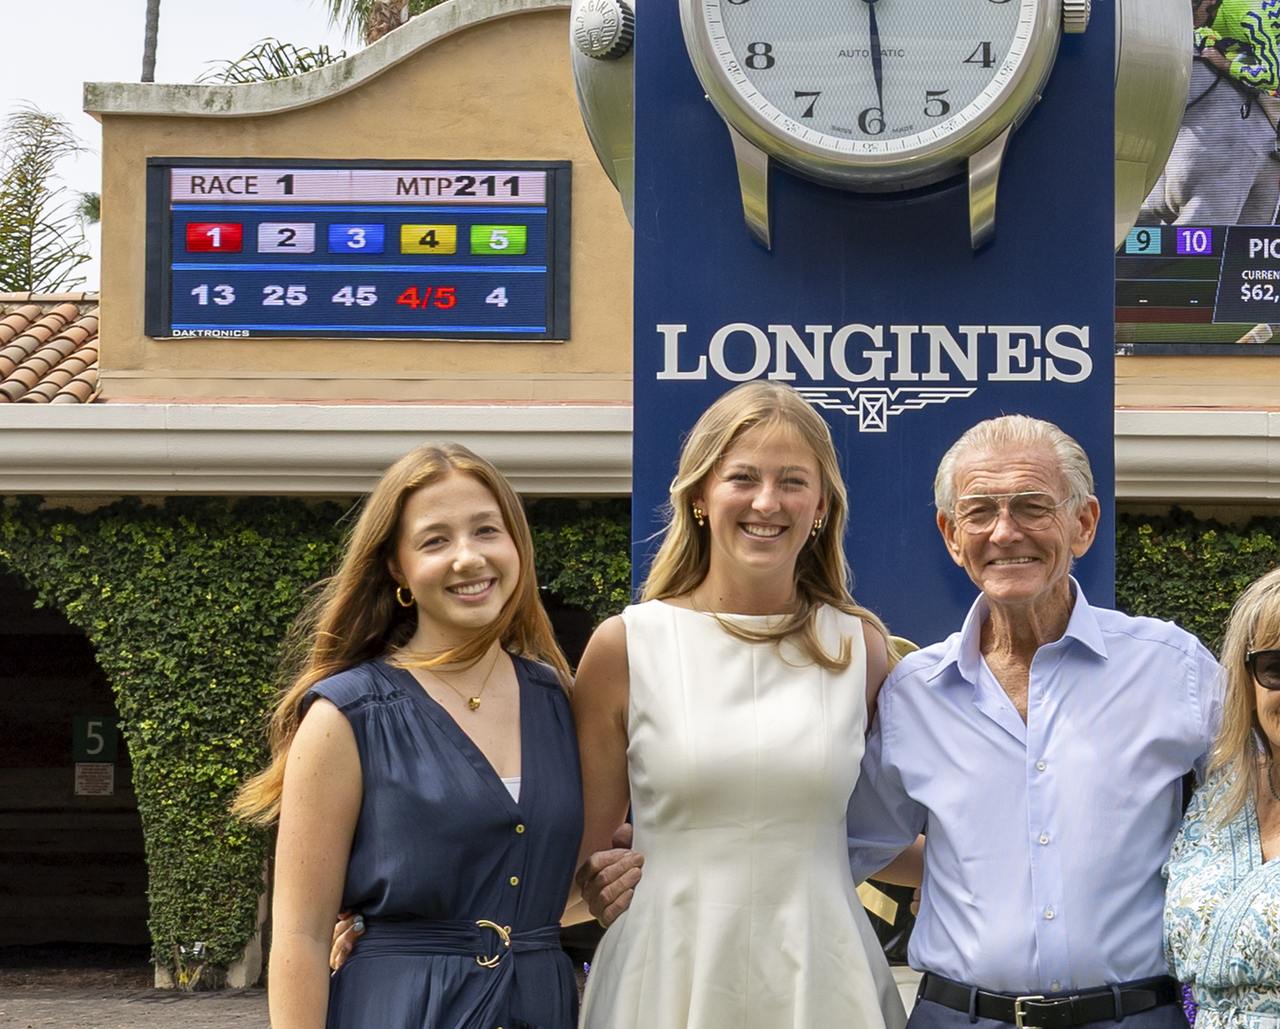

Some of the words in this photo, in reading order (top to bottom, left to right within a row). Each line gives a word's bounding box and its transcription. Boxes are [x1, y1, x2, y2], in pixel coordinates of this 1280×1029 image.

[745, 42, 775, 69] 8
[838, 49, 905, 58] AUTOATIC
[963, 42, 995, 68] 4
[795, 91, 821, 118] 7
[924, 89, 950, 117] 5
[858, 107, 886, 135] 6
[190, 175, 258, 195] RACE
[277, 174, 294, 195] 1
[207, 228, 221, 247] 1
[277, 228, 296, 247] 2
[347, 229, 366, 248] 3
[419, 230, 439, 248] 4
[490, 230, 509, 249] 5
[1137, 230, 1151, 251] 9
[1182, 231, 1207, 252] 10
[191, 285, 235, 305] 13
[263, 286, 307, 305] 25
[332, 286, 377, 306] 45
[397, 287, 457, 309] 4/5
[486, 287, 508, 308] 4
[172, 329, 250, 337] DAKTRONICS
[656, 323, 1093, 383] LONGINES
[86, 721, 104, 755] 5
